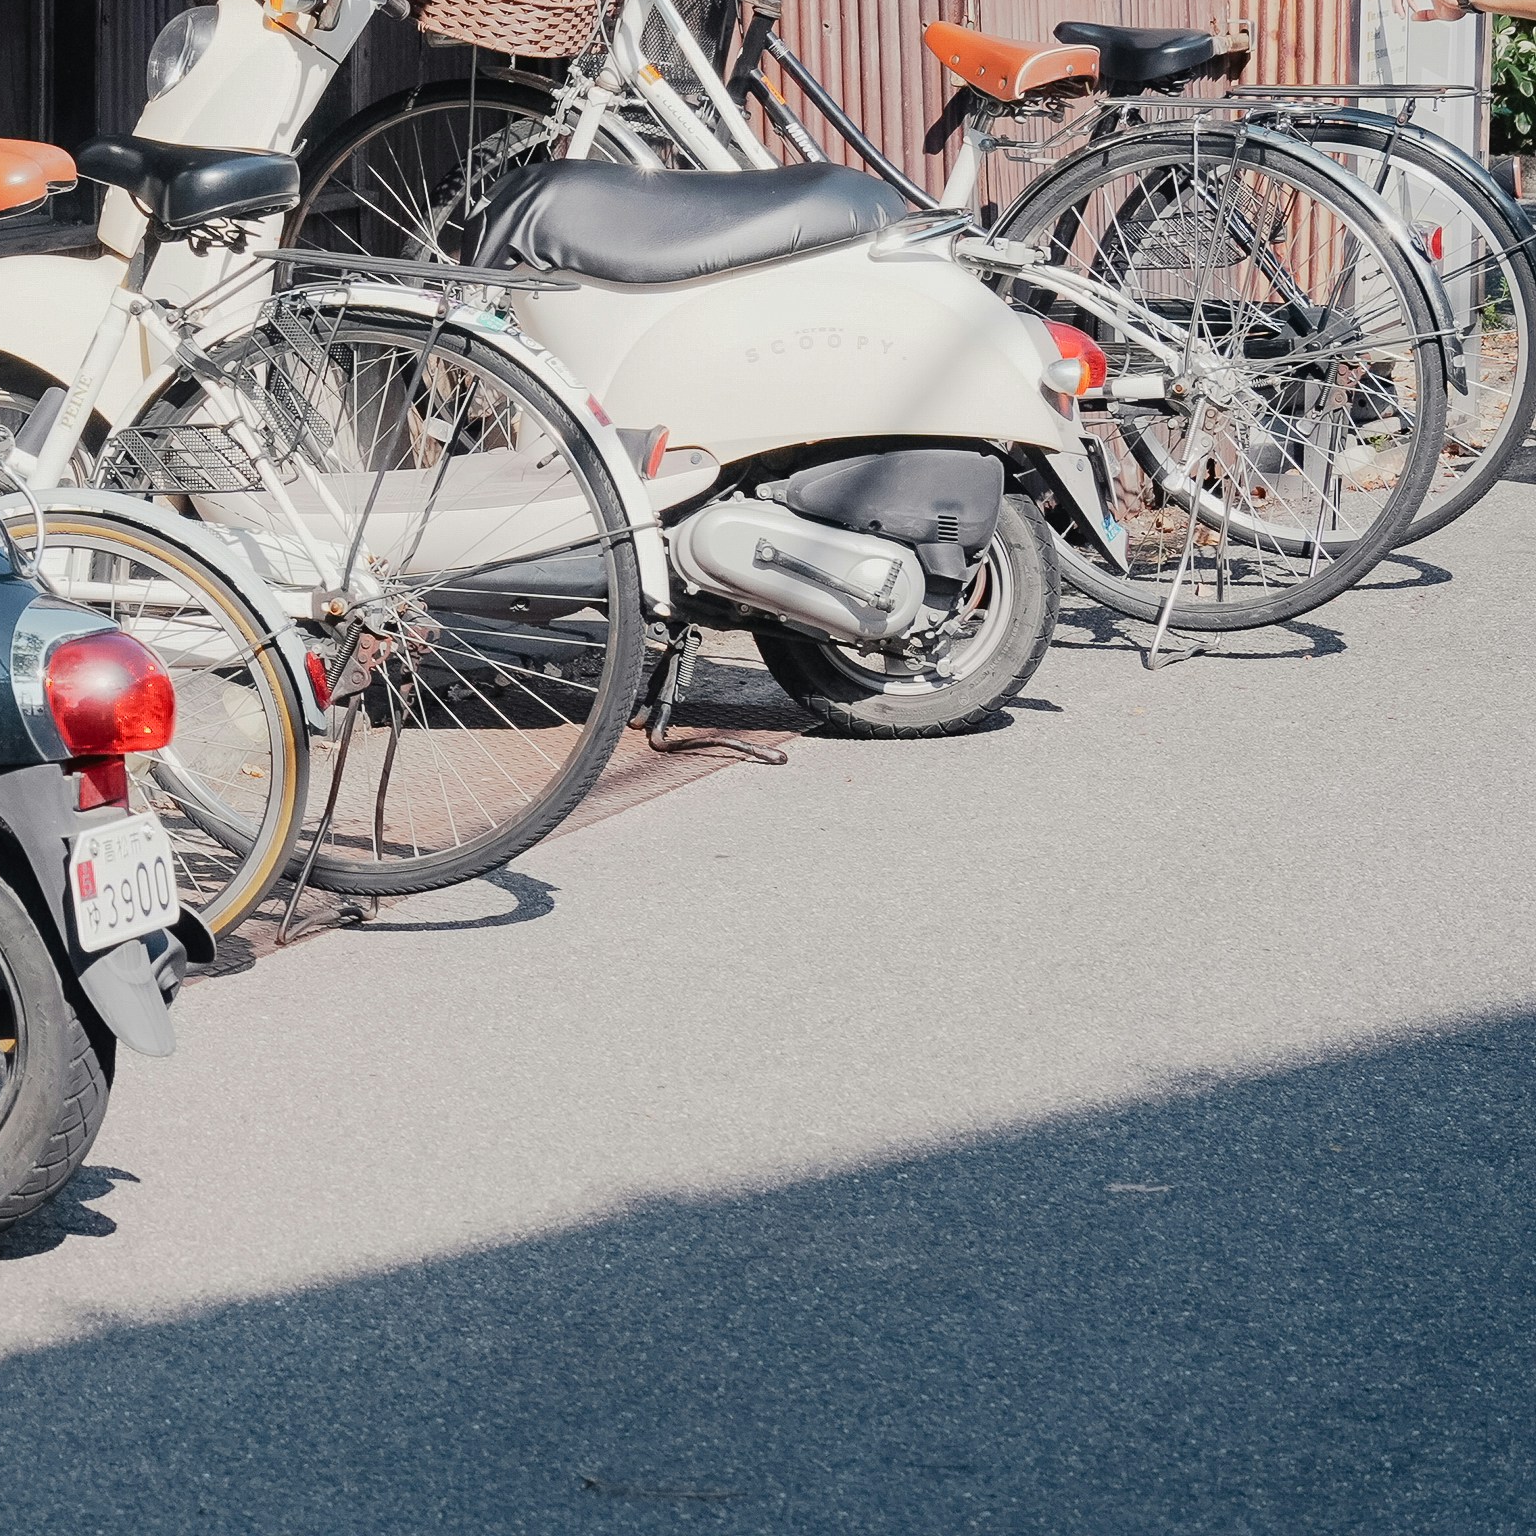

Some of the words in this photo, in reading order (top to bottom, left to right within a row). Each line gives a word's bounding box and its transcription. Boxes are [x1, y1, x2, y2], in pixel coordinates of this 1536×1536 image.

[61, 374, 93, 430] PEINE
[102, 831, 142, 863] 高松市
[103, 856, 170, 929] 3900
